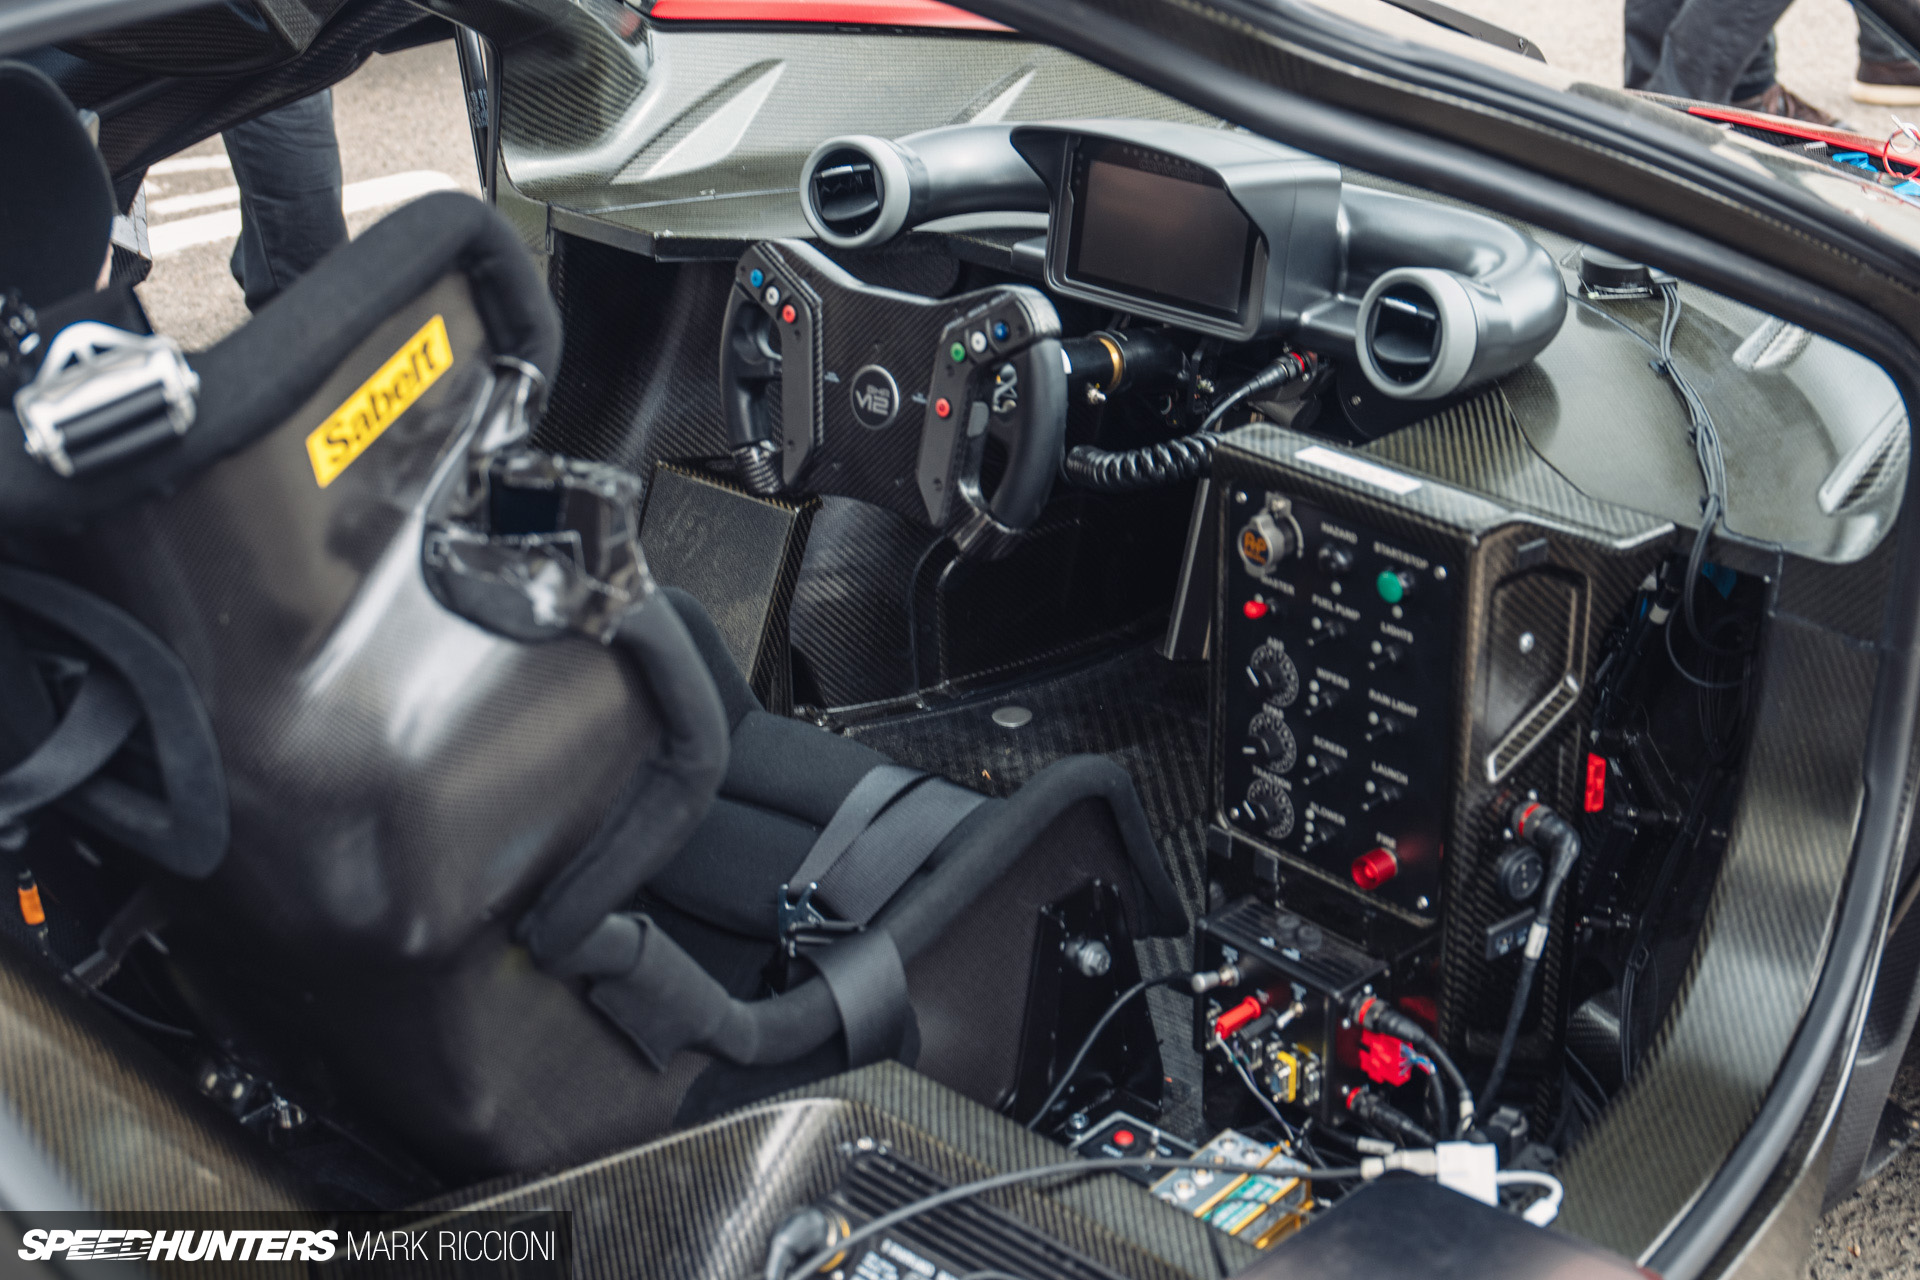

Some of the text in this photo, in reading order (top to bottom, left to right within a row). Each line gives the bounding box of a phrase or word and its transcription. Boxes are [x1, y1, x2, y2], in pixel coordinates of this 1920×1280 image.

[323, 340, 436, 464] Sabelt
[1321, 520, 1358, 545] HAZARD
[1311, 592, 1361, 621] FUEL PUMP
[1380, 620, 1414, 644] LIGHTS
[1316, 666, 1350, 690] WIPERS
[1368, 687, 1418, 718] RAIN LIGHT
[1312, 734, 1348, 759] SCREEN
[1252, 764, 1292, 791] TRACTION
[1371, 760, 1409, 786] LAUNCH
[1309, 801, 1347, 826] BLOWER
[1376, 831, 1397, 849] FIRE
